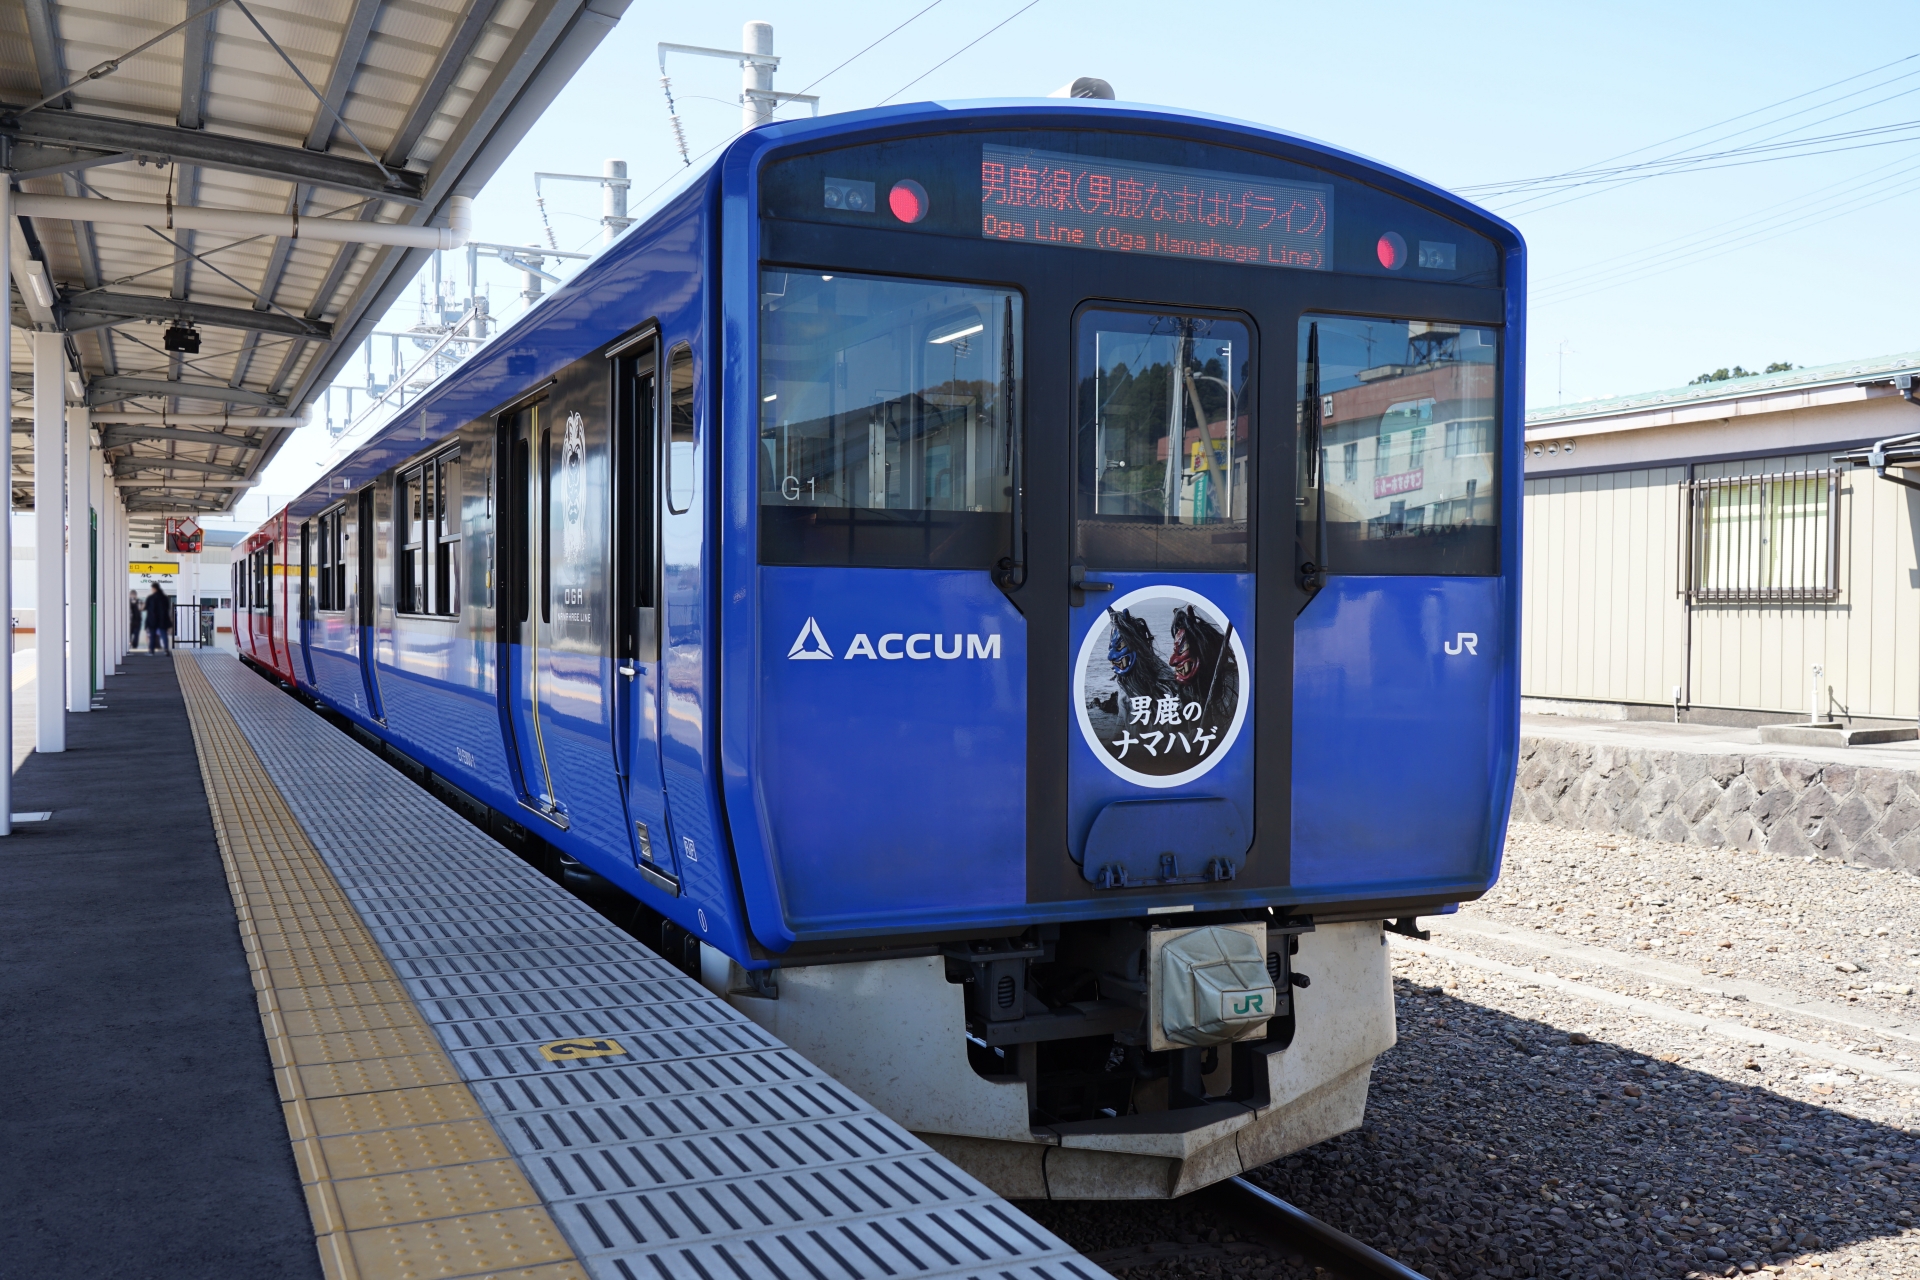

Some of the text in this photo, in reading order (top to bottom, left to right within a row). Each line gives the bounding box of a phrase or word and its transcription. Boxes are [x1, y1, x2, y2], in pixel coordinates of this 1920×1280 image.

[984, 214, 1322, 269] Oga Line (Oga Namahage Line)
[781, 476, 816, 501] G1
[564, 588, 583, 605] OGA
[580, 613, 591, 623] LINE
[843, 633, 1001, 660] ACCUM
[1444, 632, 1479, 656] JR
[1129, 693, 1203, 726] 男鹿の
[1112, 726, 1218, 760] ナマハゲ
[1233, 994, 1263, 1014] JR
[549, 1041, 612, 1055] 2
